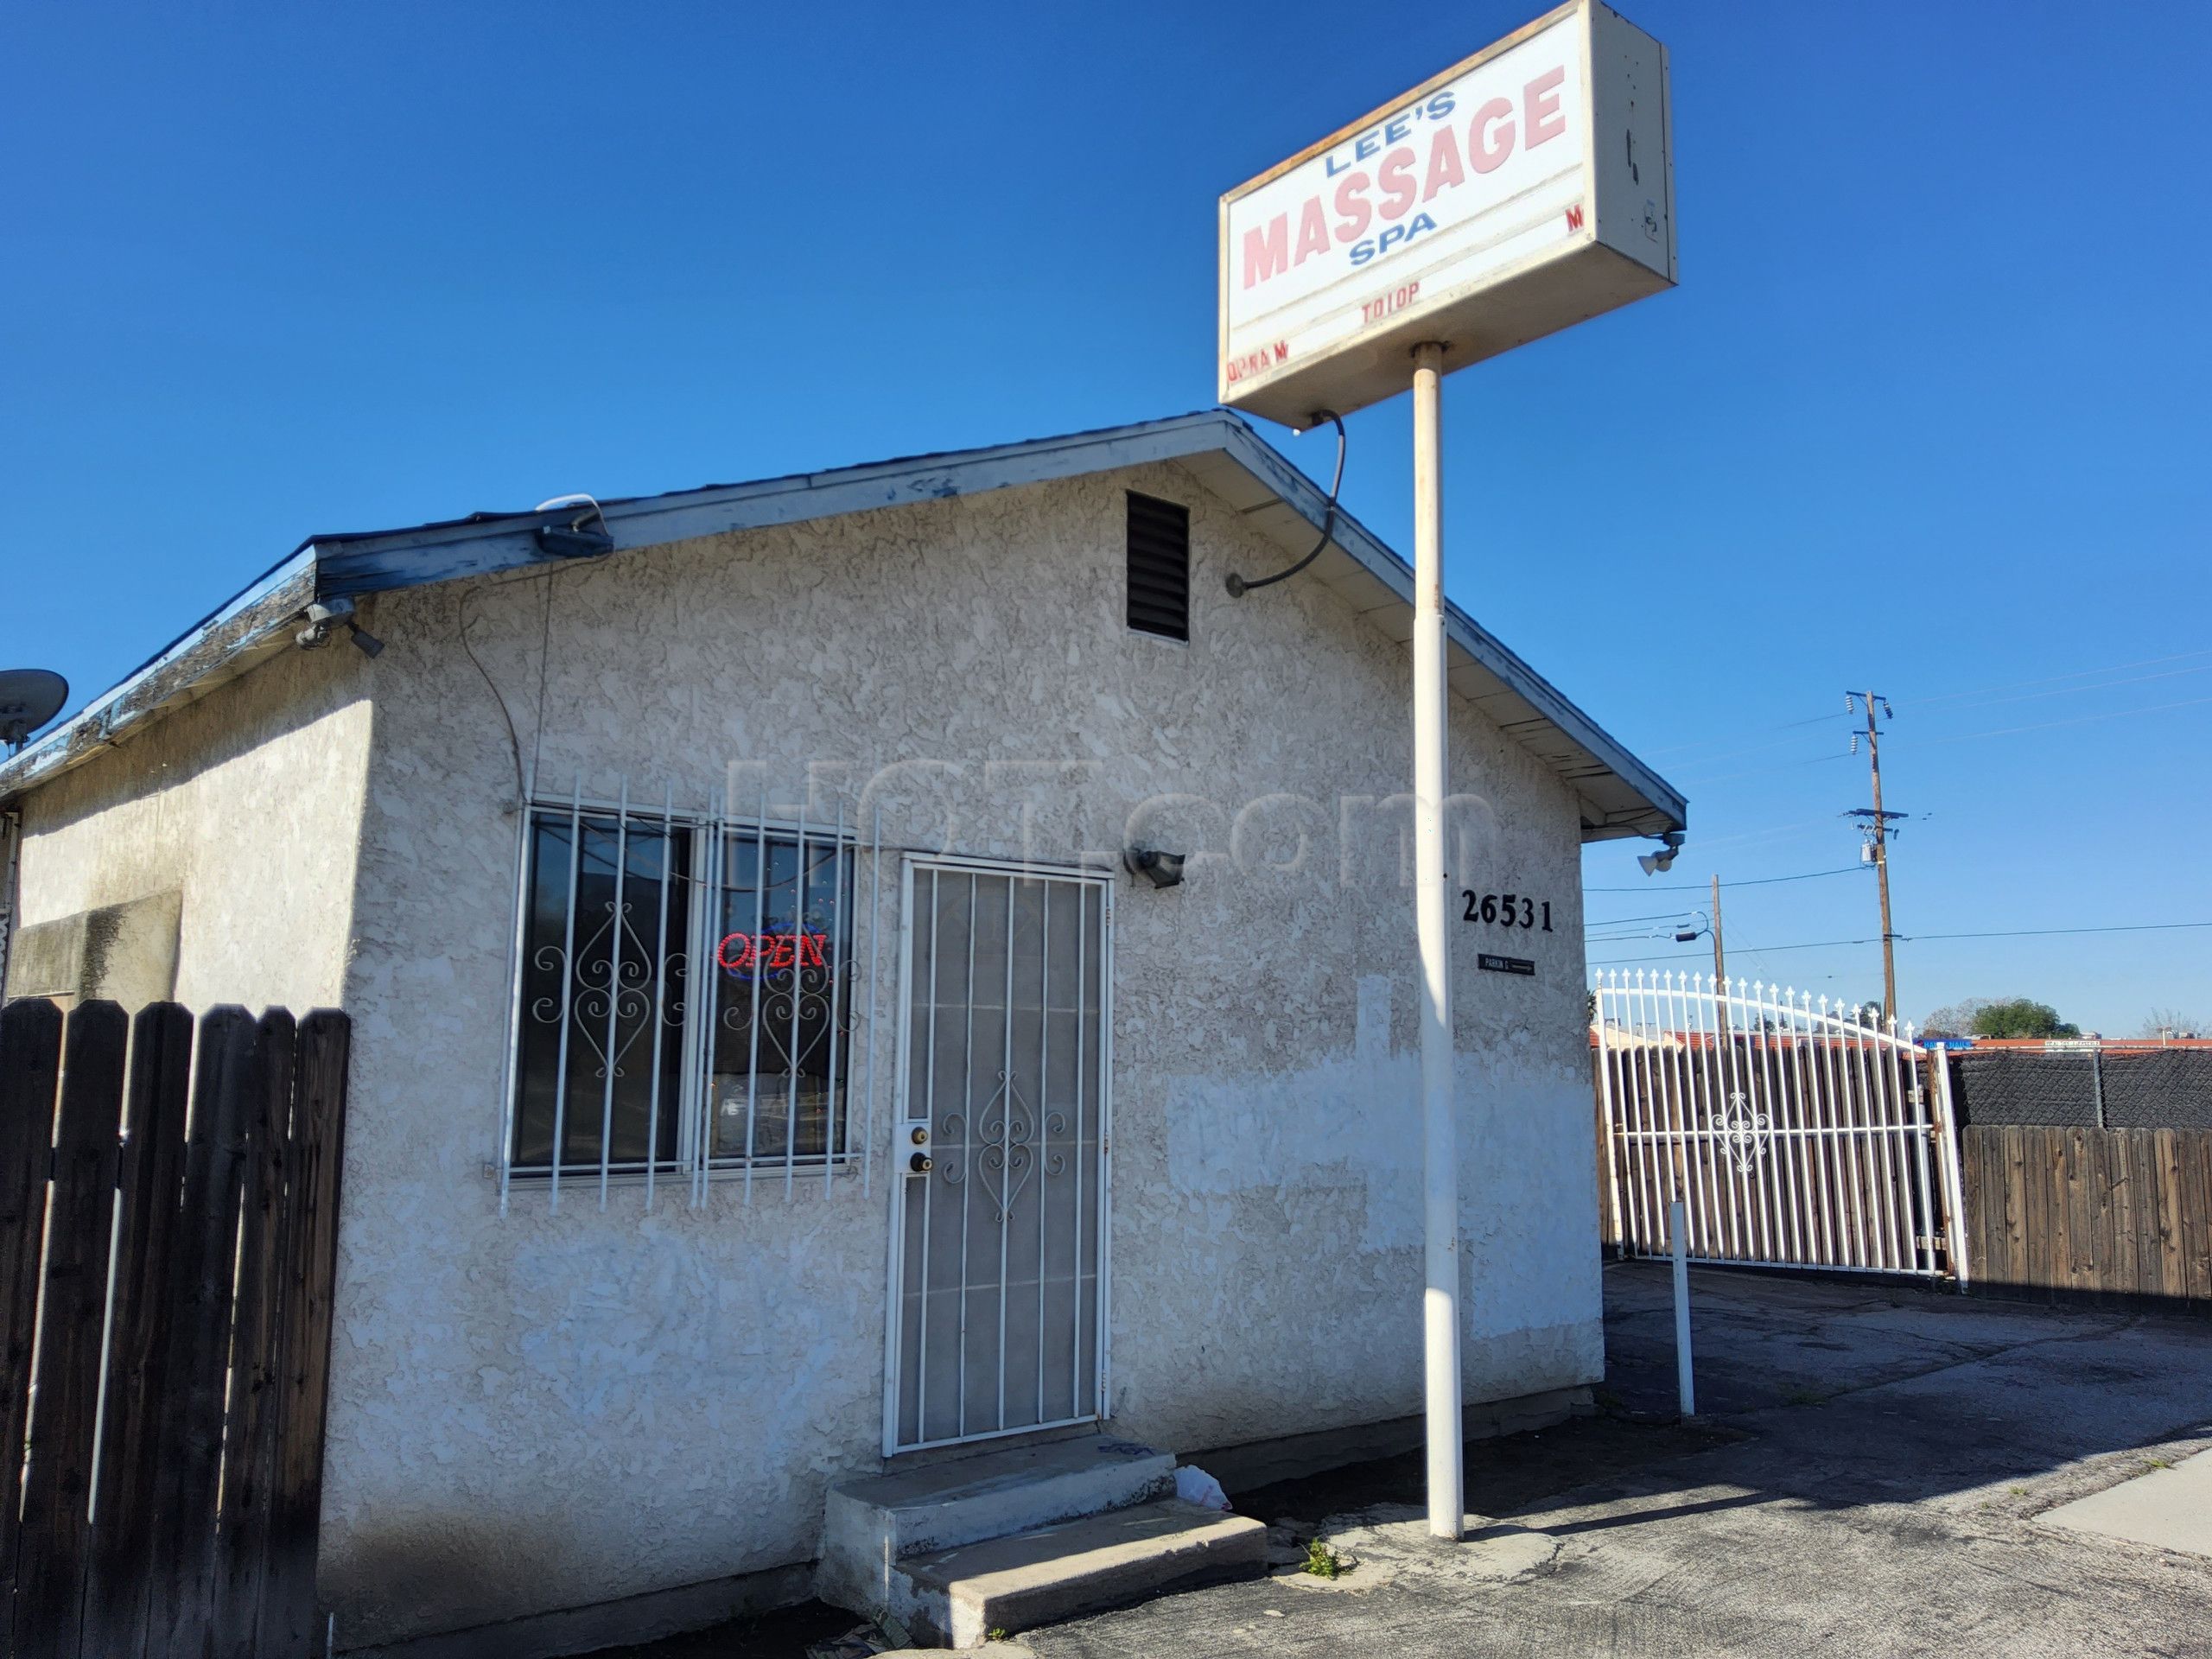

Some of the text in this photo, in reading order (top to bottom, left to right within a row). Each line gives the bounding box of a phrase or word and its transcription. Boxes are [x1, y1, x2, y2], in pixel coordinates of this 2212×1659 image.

[1326, 91, 1456, 178] LEE'S
[1243, 65, 1567, 290] MASSAGE
[1349, 213, 1438, 266] SPA
[1462, 889, 1554, 933] 26531
[717, 933, 827, 968] OPEN
